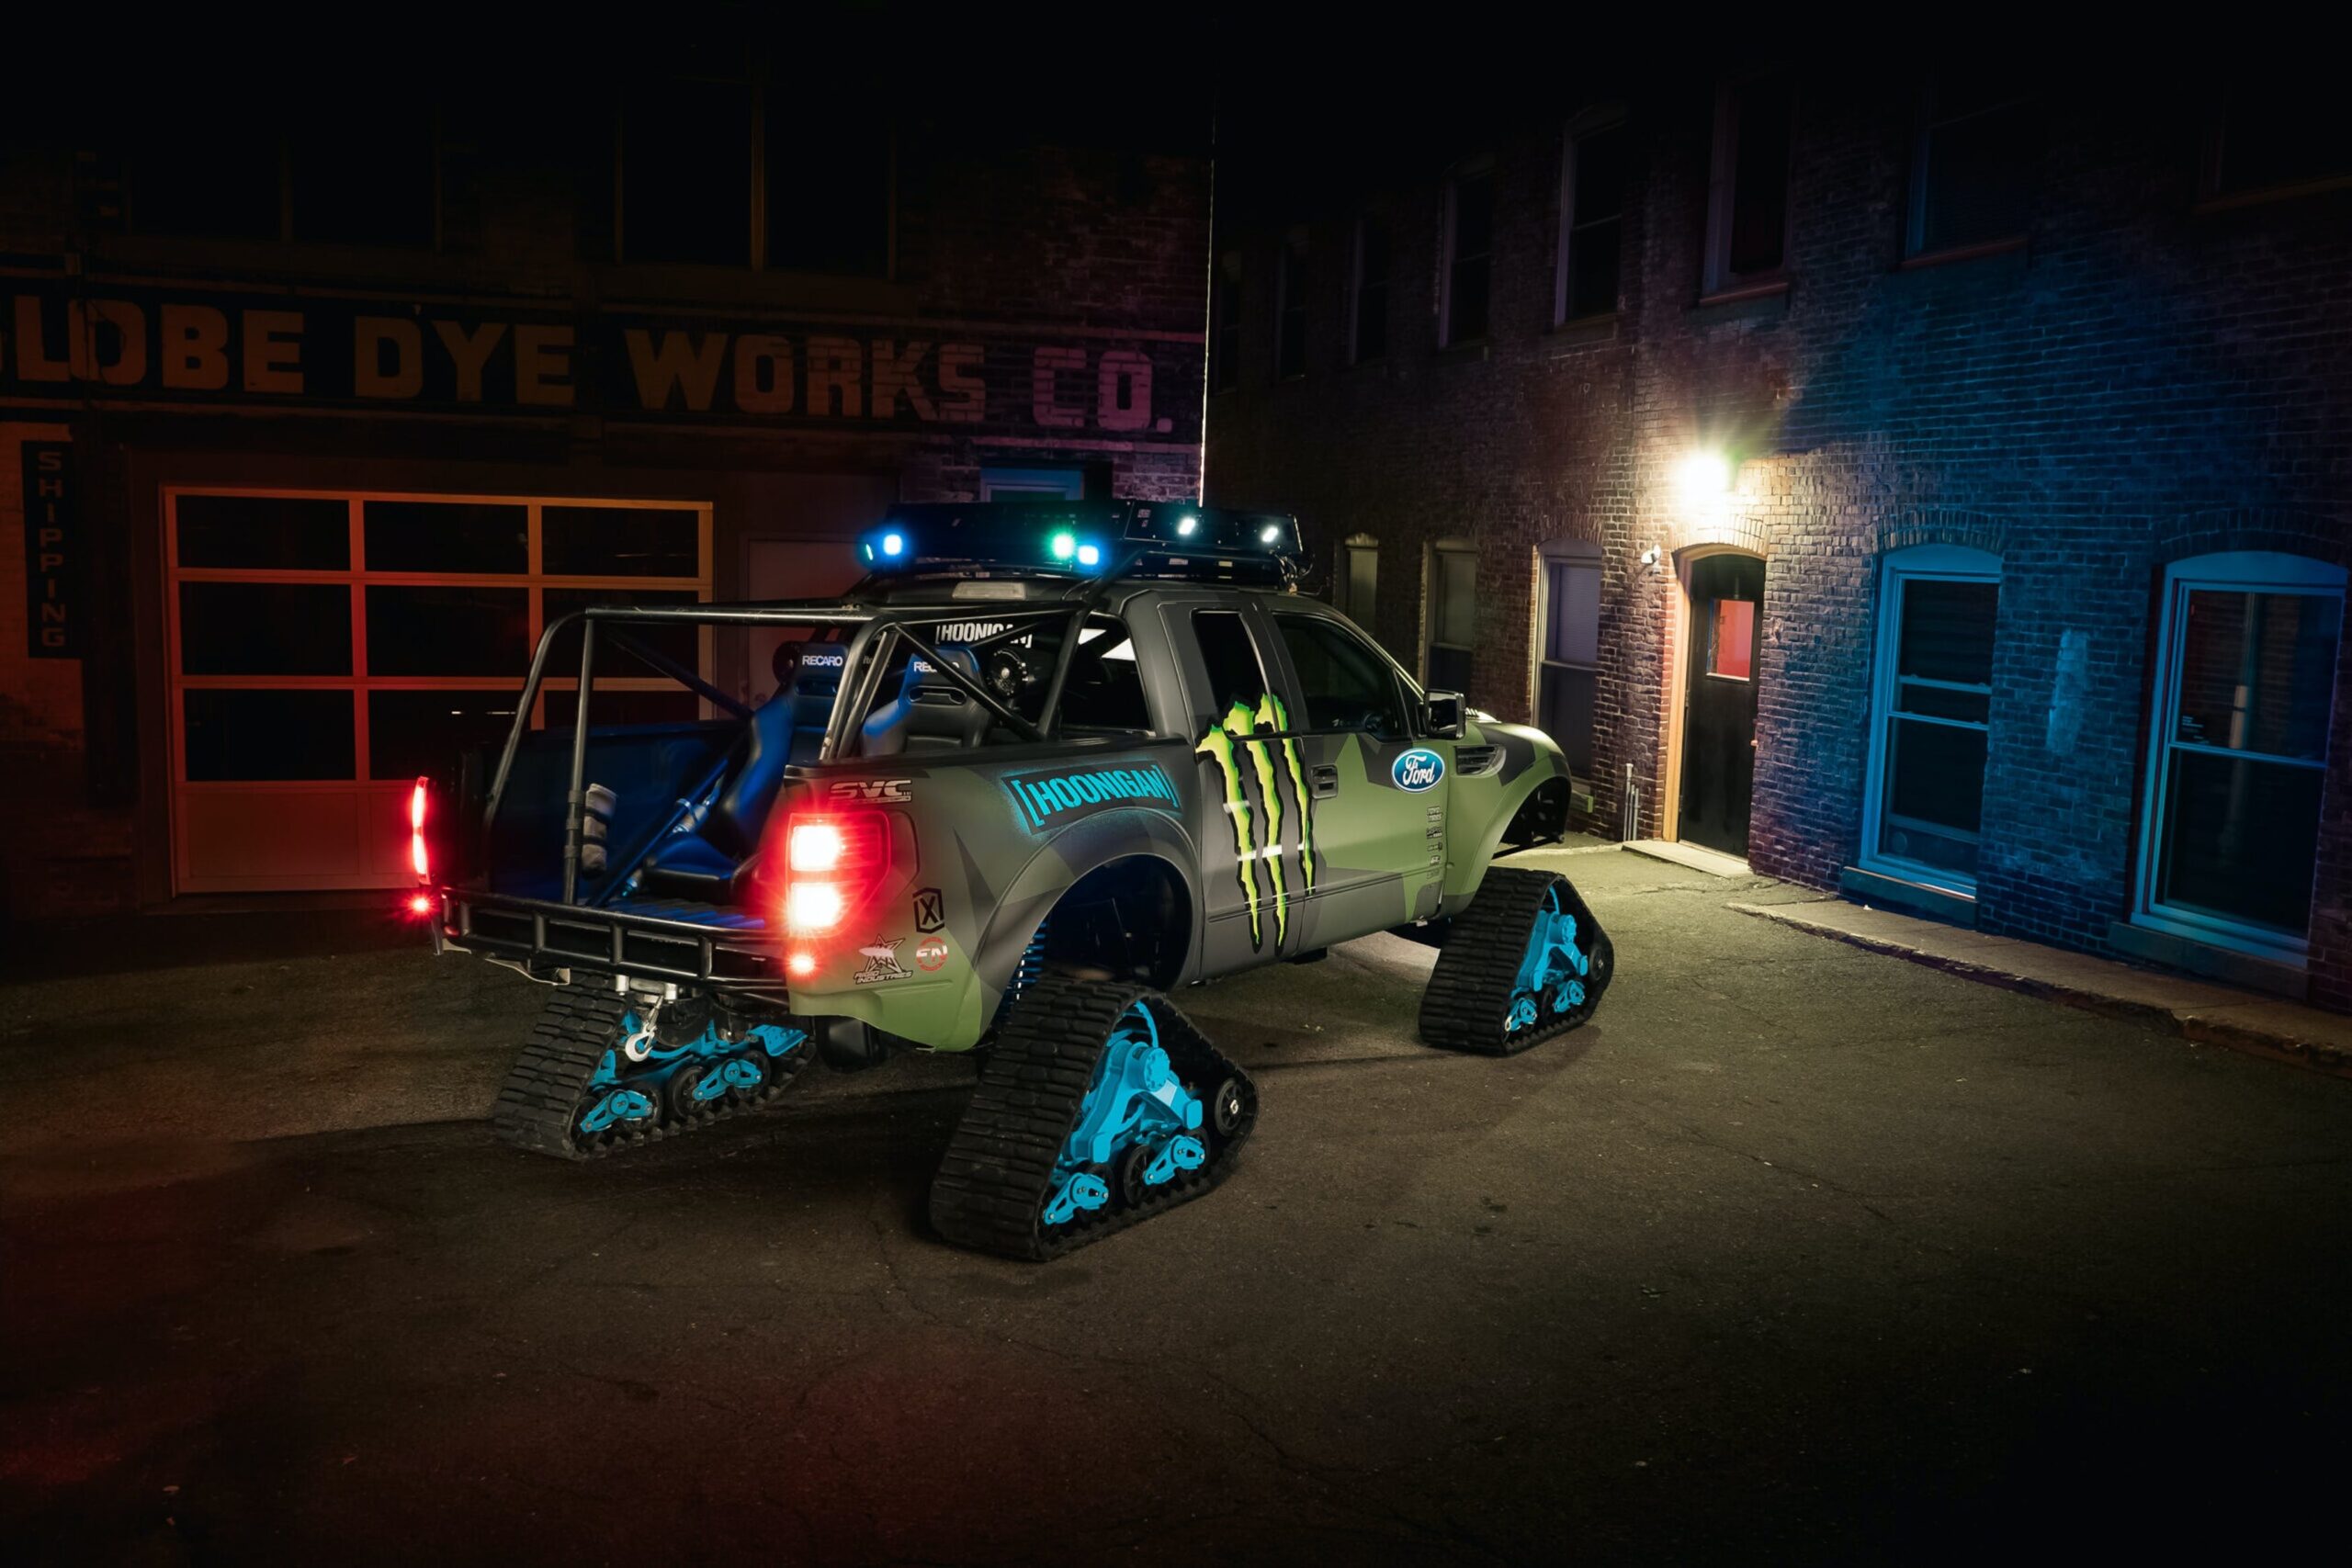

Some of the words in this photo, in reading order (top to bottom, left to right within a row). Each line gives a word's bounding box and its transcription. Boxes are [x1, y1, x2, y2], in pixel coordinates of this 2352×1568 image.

[0, 293, 305, 394] LOBE
[354, 315, 576, 406] DYE
[624, 327, 987, 423] WORKS
[1032, 344, 1173, 434] CO.
[38, 451, 66, 648] SHIPPING
[802, 656, 843, 667] RECARO
[1402, 754, 1435, 786] Ford
[829, 779, 912, 801] SVC
